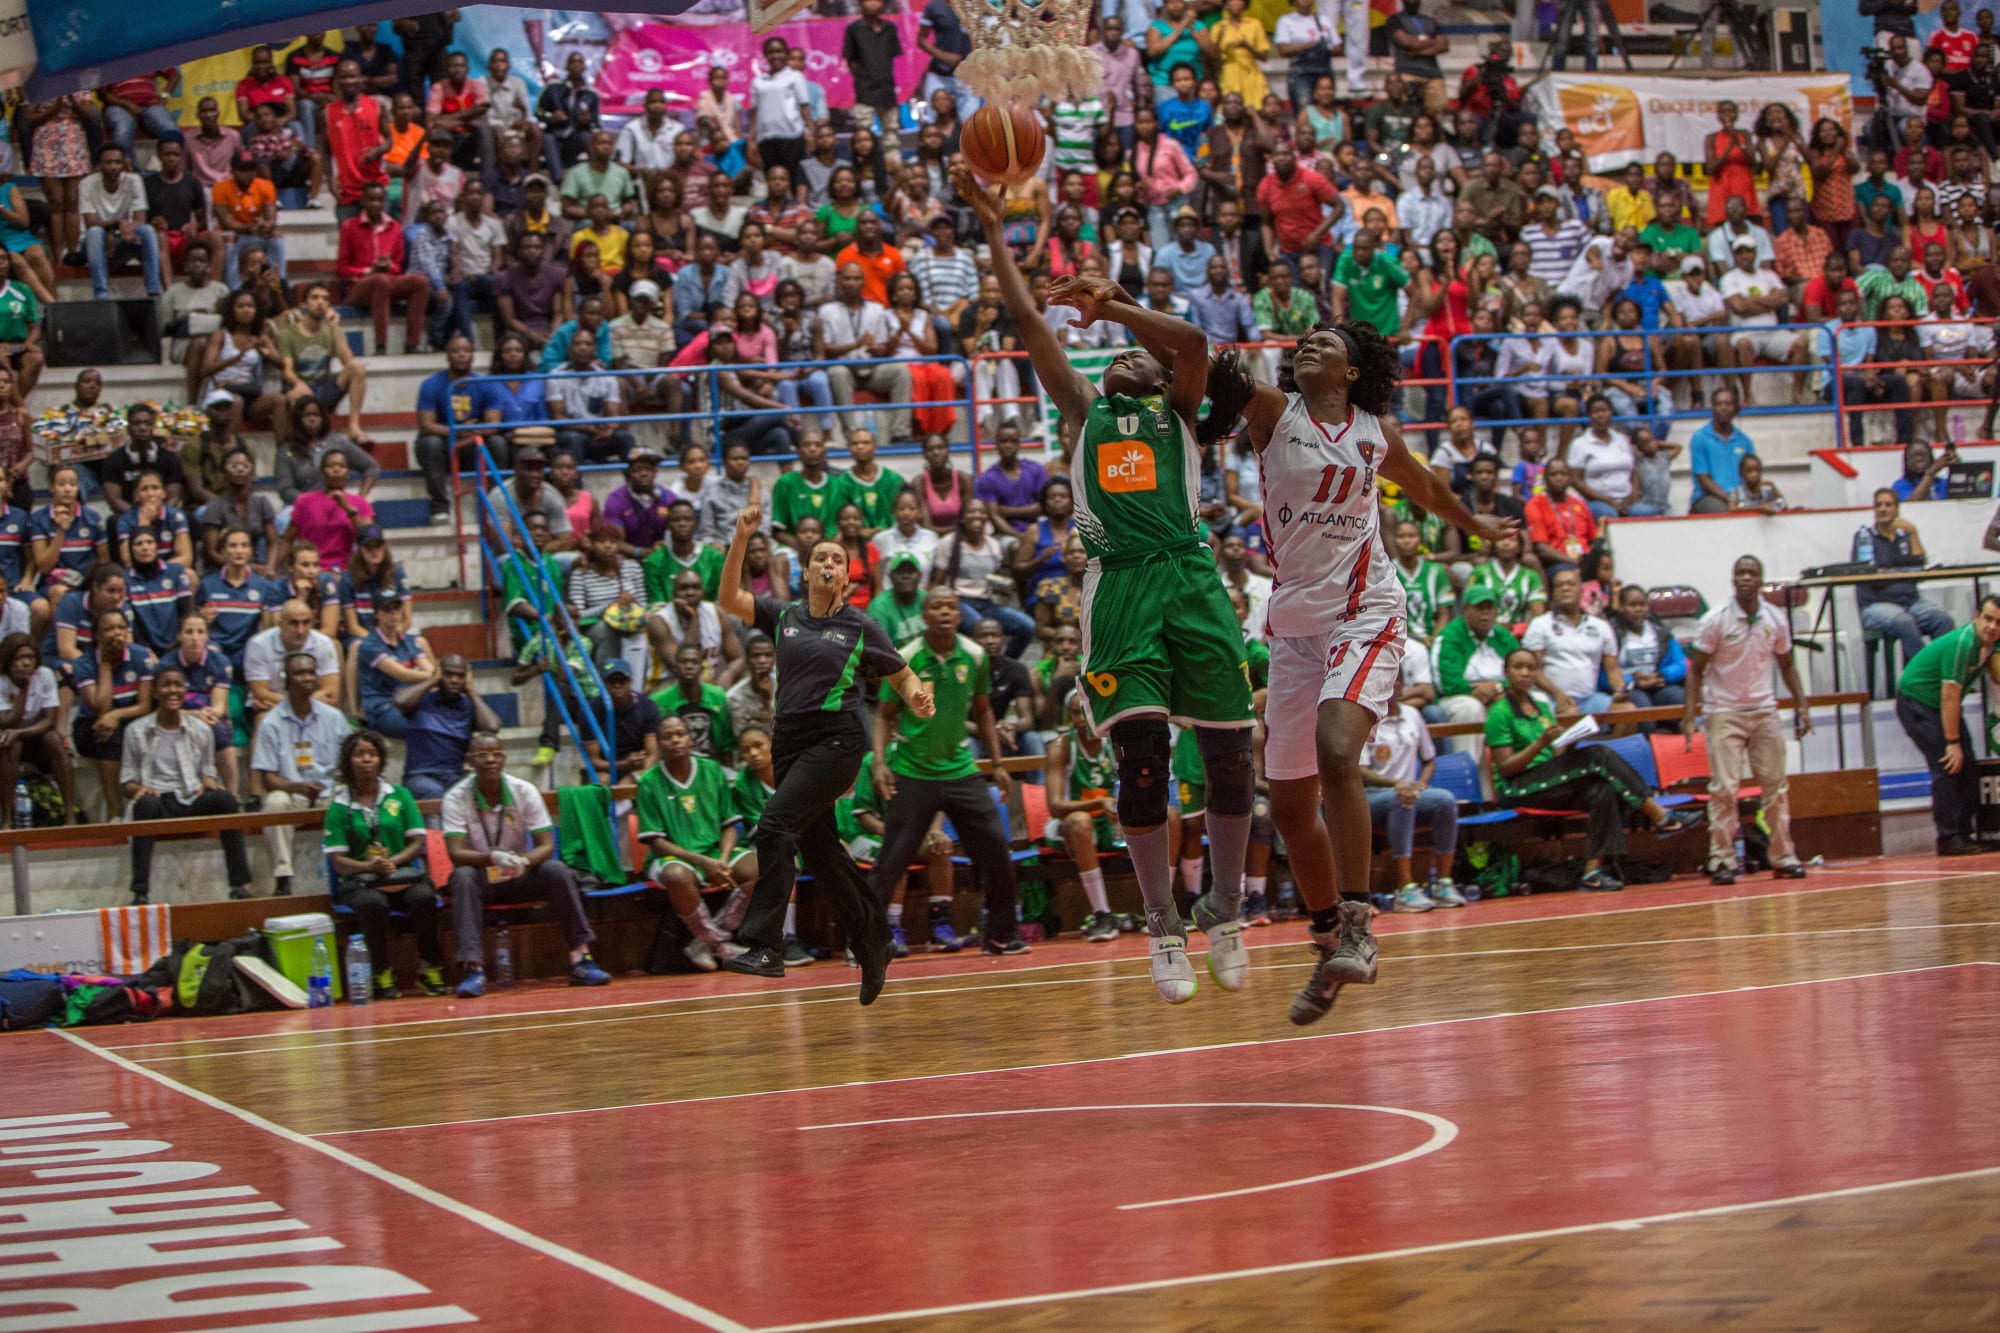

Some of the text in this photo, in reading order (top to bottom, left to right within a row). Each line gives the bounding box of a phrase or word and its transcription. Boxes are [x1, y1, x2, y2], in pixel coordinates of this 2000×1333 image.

[1107, 462, 1136, 478] BCI
[1312, 464, 1356, 503] 11
[1087, 671, 1118, 697] 6
[1090, 767, 1104, 786] 5
